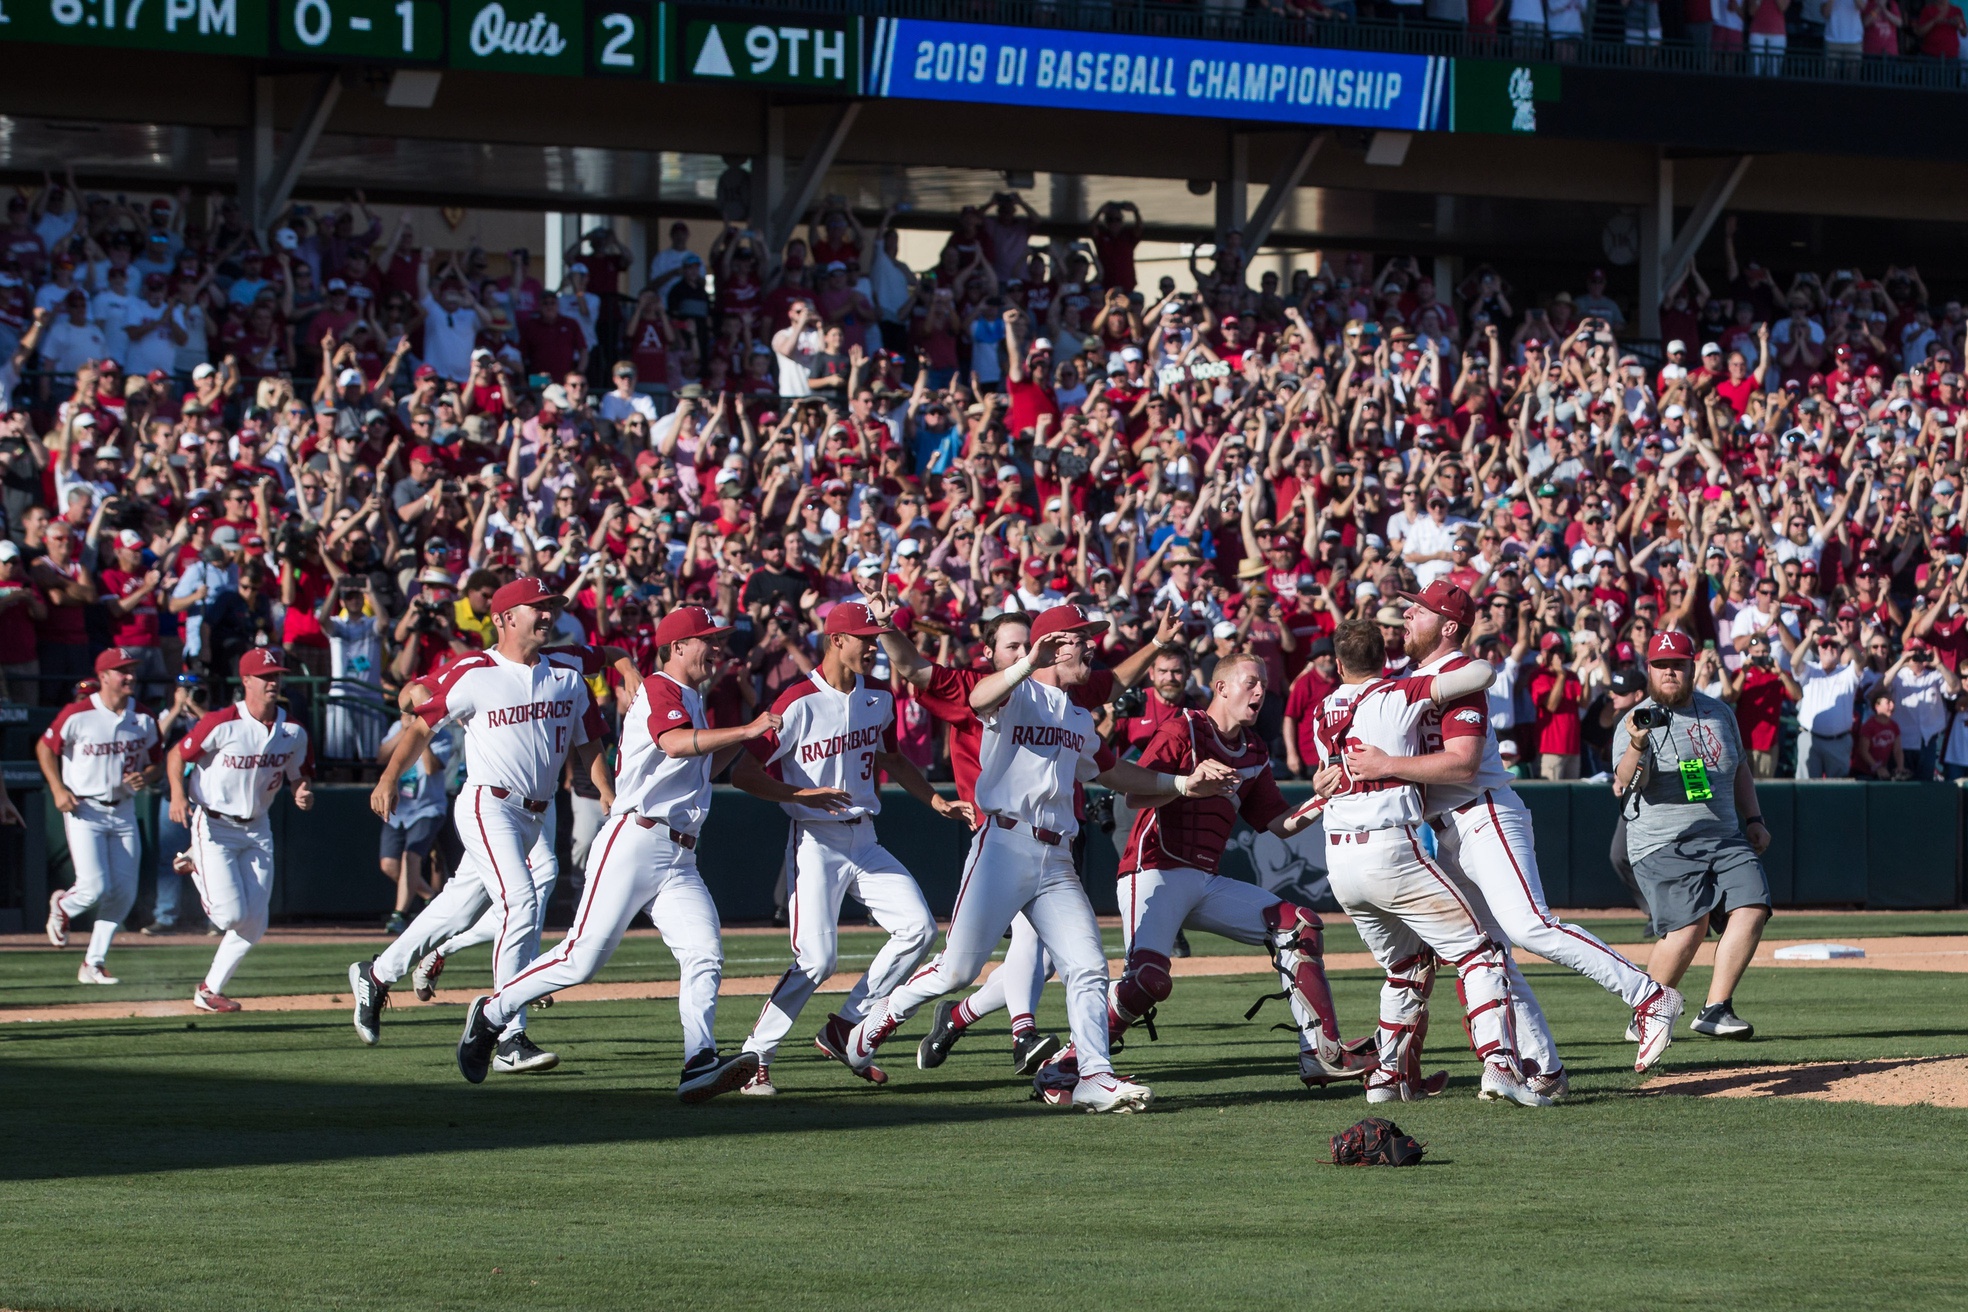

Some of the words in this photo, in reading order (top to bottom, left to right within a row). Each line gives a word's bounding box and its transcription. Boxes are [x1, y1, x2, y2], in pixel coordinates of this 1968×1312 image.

[165, 0, 237, 37] PM
[293, 0, 332, 46] 0
[395, 0, 414, 52] 1
[469, 1, 568, 57] Outs
[601, 12, 636, 66] 2
[743, 25, 845, 80] 9TH
[914, 40, 988, 84] 2019
[1036, 48, 1176, 97] BASEBALL
[1187, 58, 1402, 111] CHAMPIONSHIP
[642, 324, 662, 348] A
[262, 650, 277, 665] A
[1658, 634, 1676, 651] A
[487, 700, 573, 728] RAZORBACKS
[555, 726, 567, 754] 13
[860, 751, 874, 781] 3
[1630, 769, 1642, 790] SONY
[359, 976, 370, 1008] NIKE
